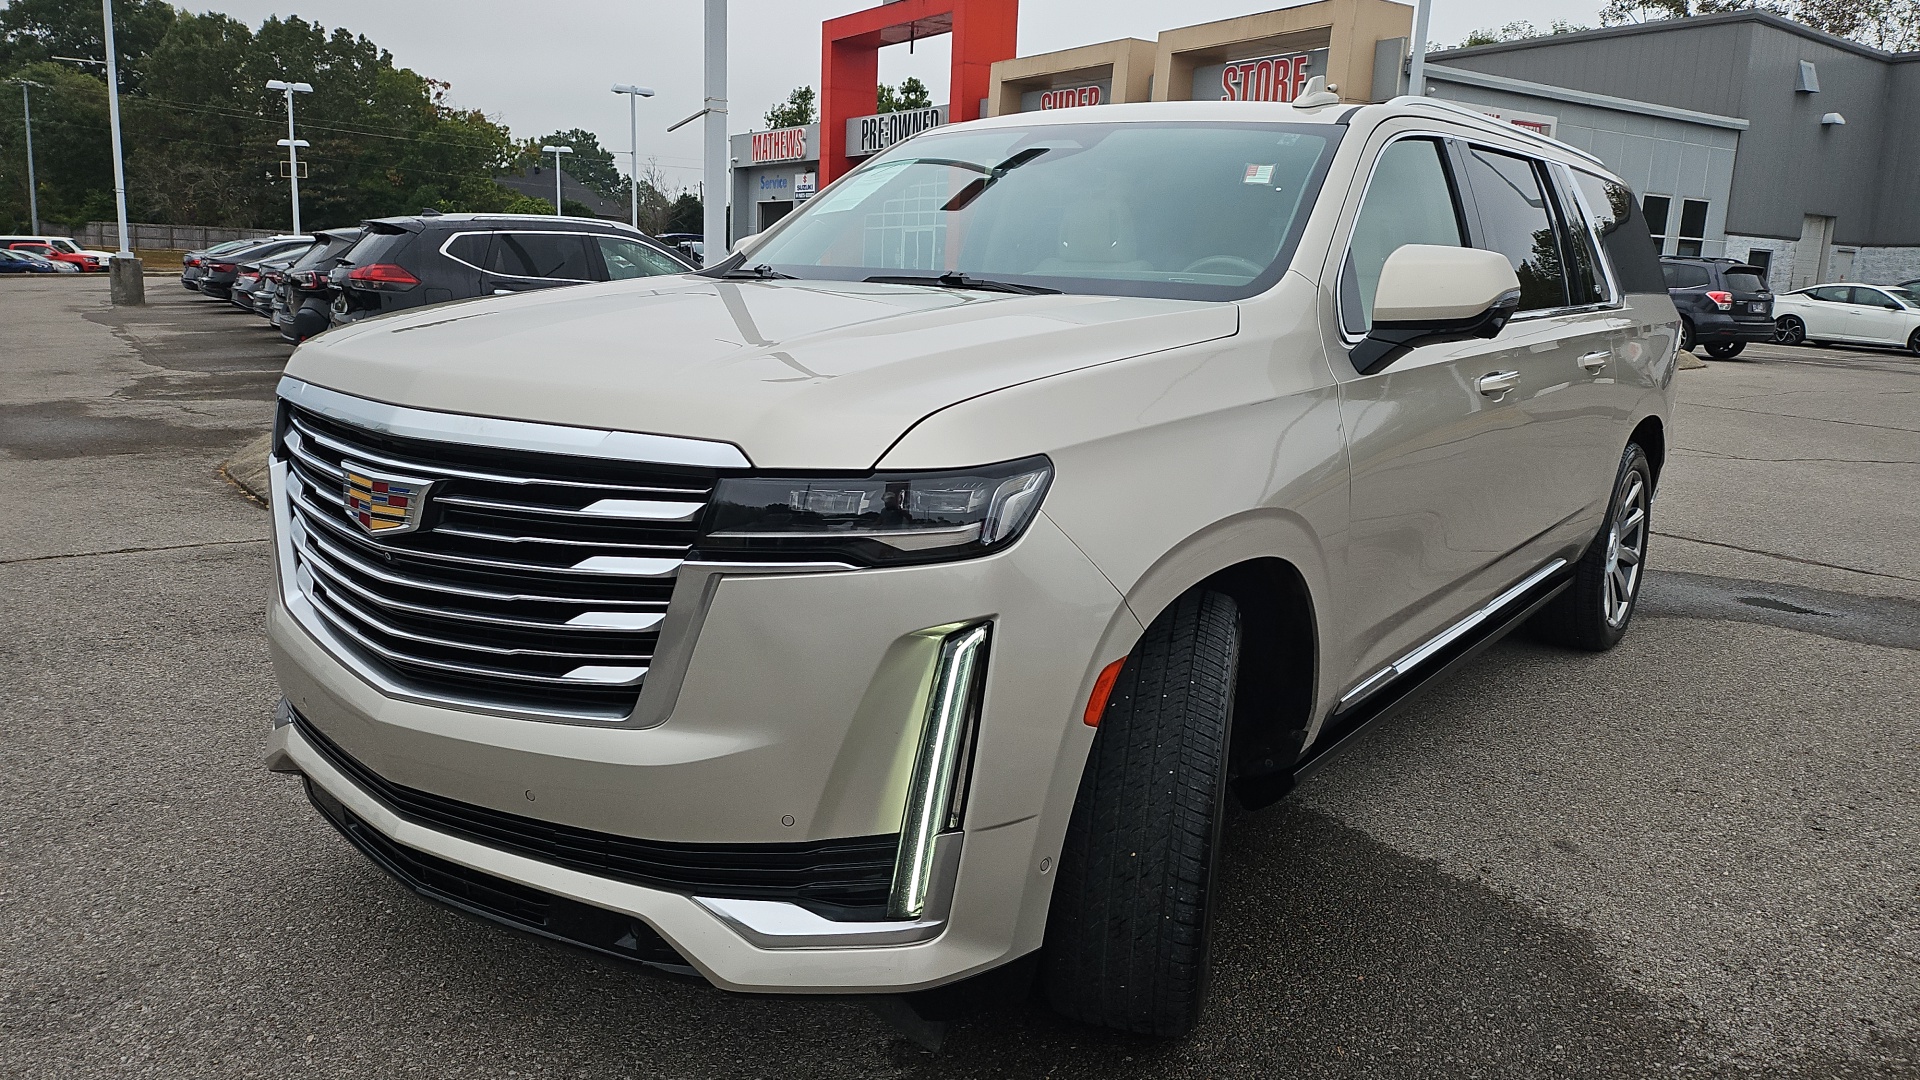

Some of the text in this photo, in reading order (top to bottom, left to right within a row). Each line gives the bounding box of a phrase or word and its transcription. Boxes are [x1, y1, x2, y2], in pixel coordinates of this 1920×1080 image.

[1221, 56, 1308, 102] STORE
[752, 128, 804, 162] MATHEWS
[860, 109, 940, 151] PRE-OWNED
[760, 174, 788, 189] Service
